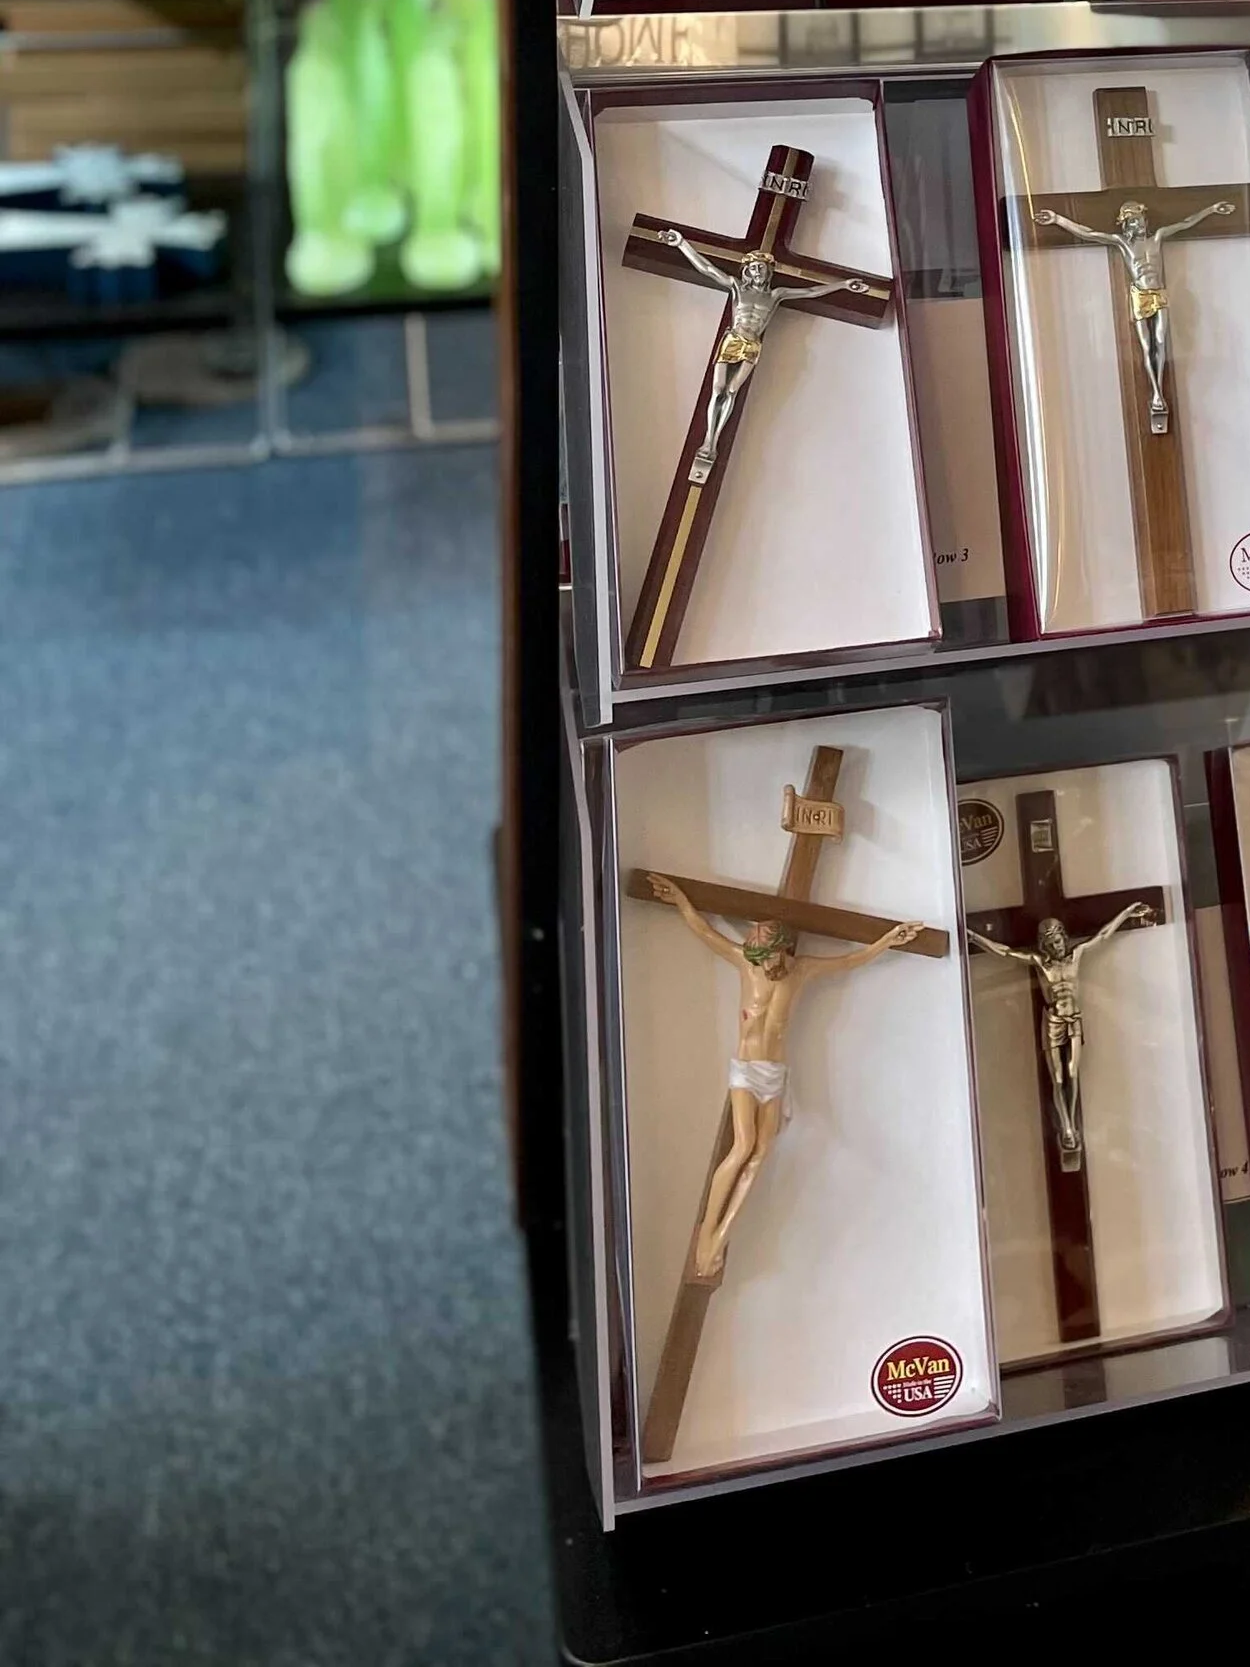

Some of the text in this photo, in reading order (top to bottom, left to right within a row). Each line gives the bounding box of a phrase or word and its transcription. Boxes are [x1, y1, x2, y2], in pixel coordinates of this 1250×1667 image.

[1107, 117, 1153, 135] INRI
[762, 172, 808, 197] INRI
[932, 548, 969, 565] ow 3
[796, 805, 832, 826] INRI
[1241, 1160, 1249, 1175] 4
[886, 1356, 951, 1381] McVan
[904, 1386, 933, 1402] USA
